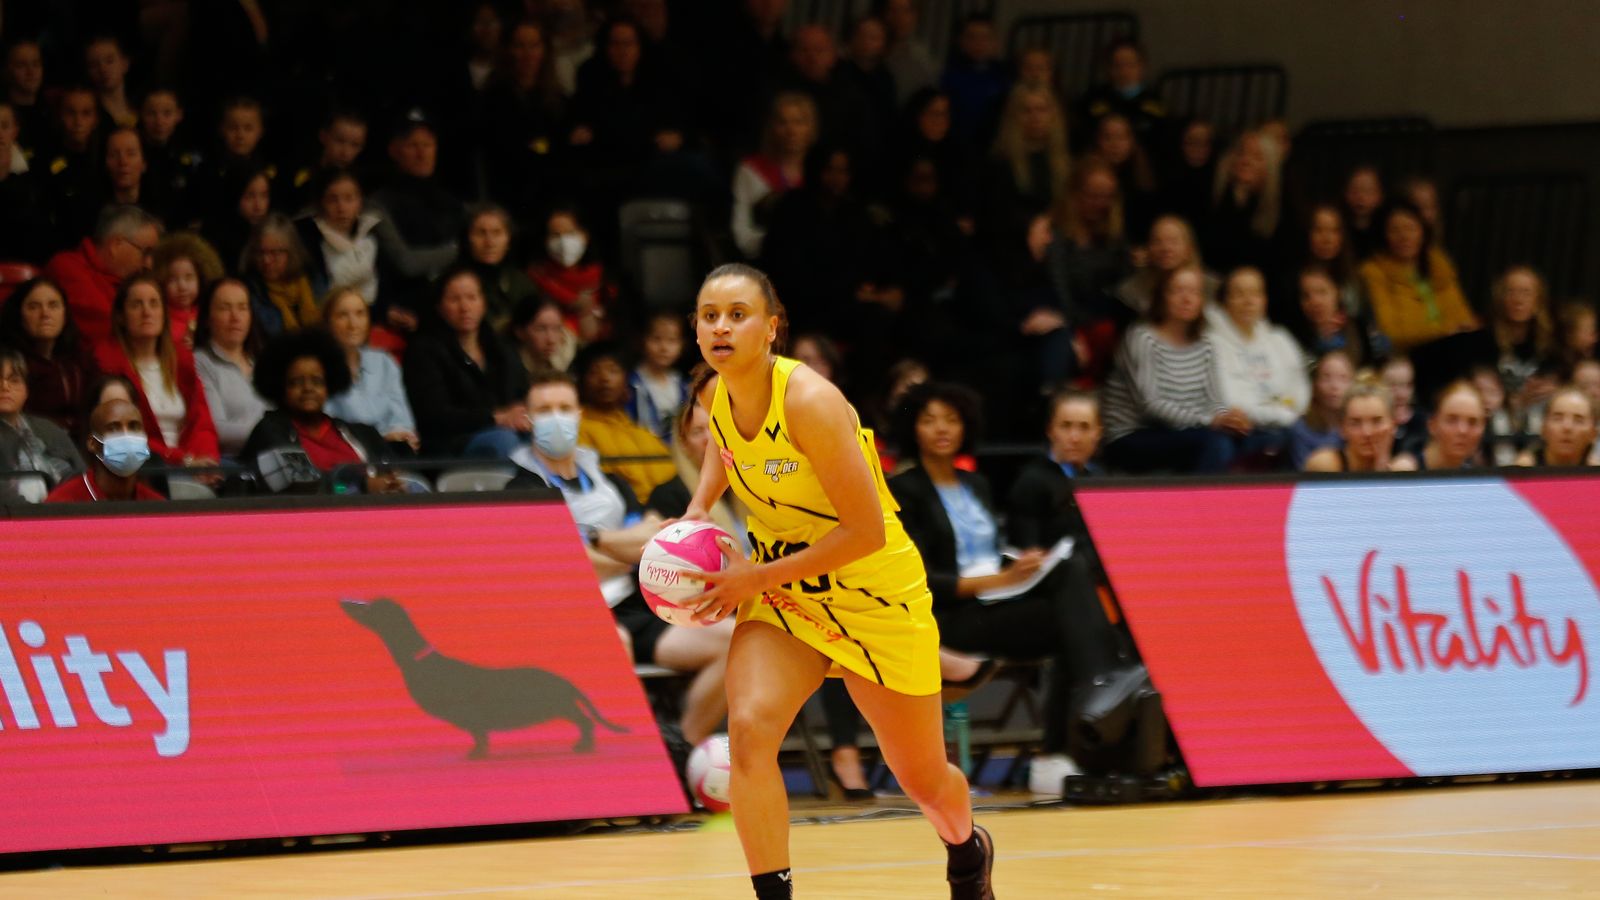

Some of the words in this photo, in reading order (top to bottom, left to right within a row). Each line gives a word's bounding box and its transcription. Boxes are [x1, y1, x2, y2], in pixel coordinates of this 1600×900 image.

[647, 562, 680, 587] Vitality
[1320, 549, 1589, 706] Vitality
[0, 620, 190, 757] lity
